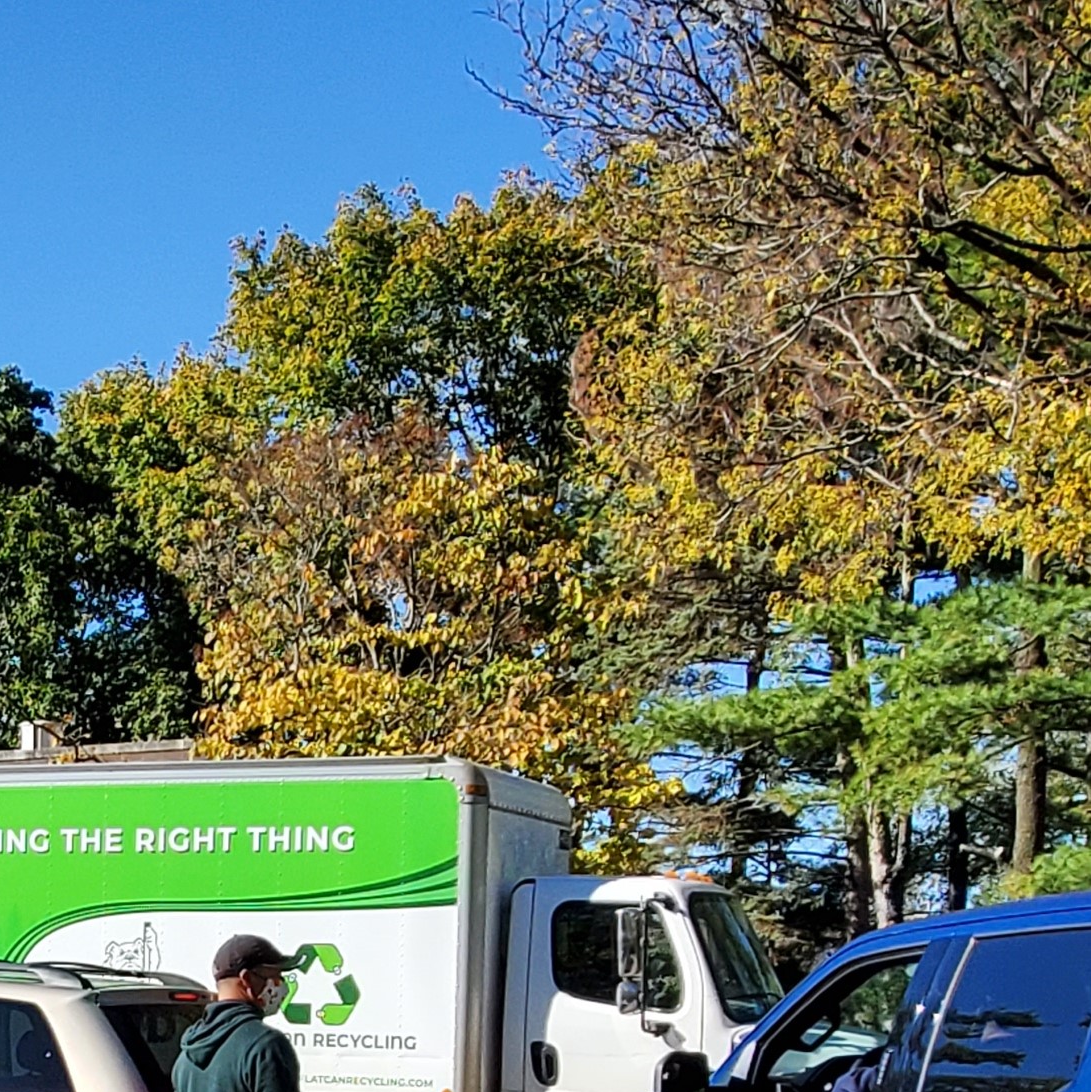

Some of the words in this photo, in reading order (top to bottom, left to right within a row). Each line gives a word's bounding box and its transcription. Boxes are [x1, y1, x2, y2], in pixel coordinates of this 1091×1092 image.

[60, 828, 124, 853] THE
[134, 826, 238, 854] RIGHT
[246, 825, 356, 853] THING
[313, 1033, 417, 1050] RECYCLING
[303, 1075, 434, 1088] LATCANRECYCLING.COM
